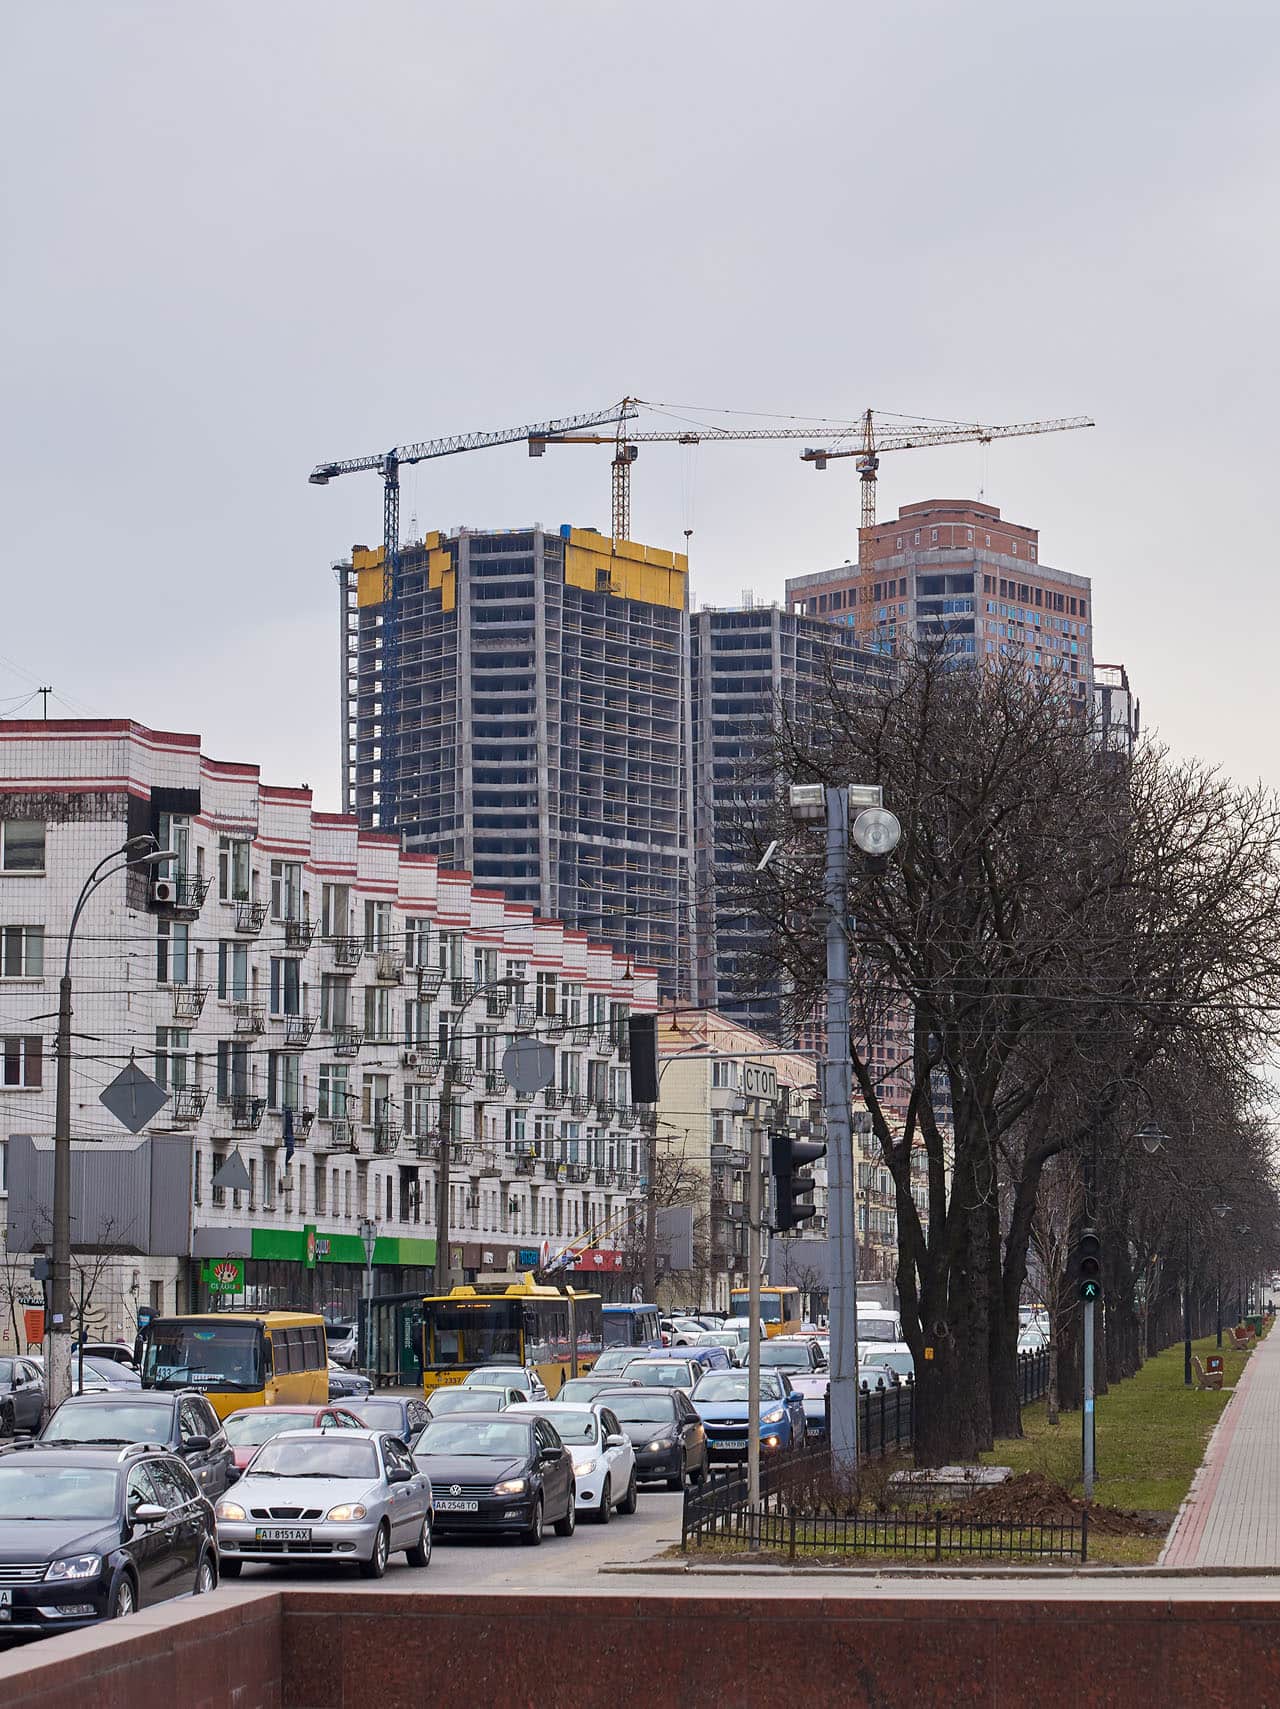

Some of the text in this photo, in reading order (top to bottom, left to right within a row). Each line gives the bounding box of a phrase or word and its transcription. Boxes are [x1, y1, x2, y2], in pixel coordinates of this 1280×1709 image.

[746, 1068, 776, 1096] СТОП
[436, 1501, 447, 1510] AA
[467, 1501, 478, 1510] TO
[261, 1530, 308, 1539] AI 8151 AX
